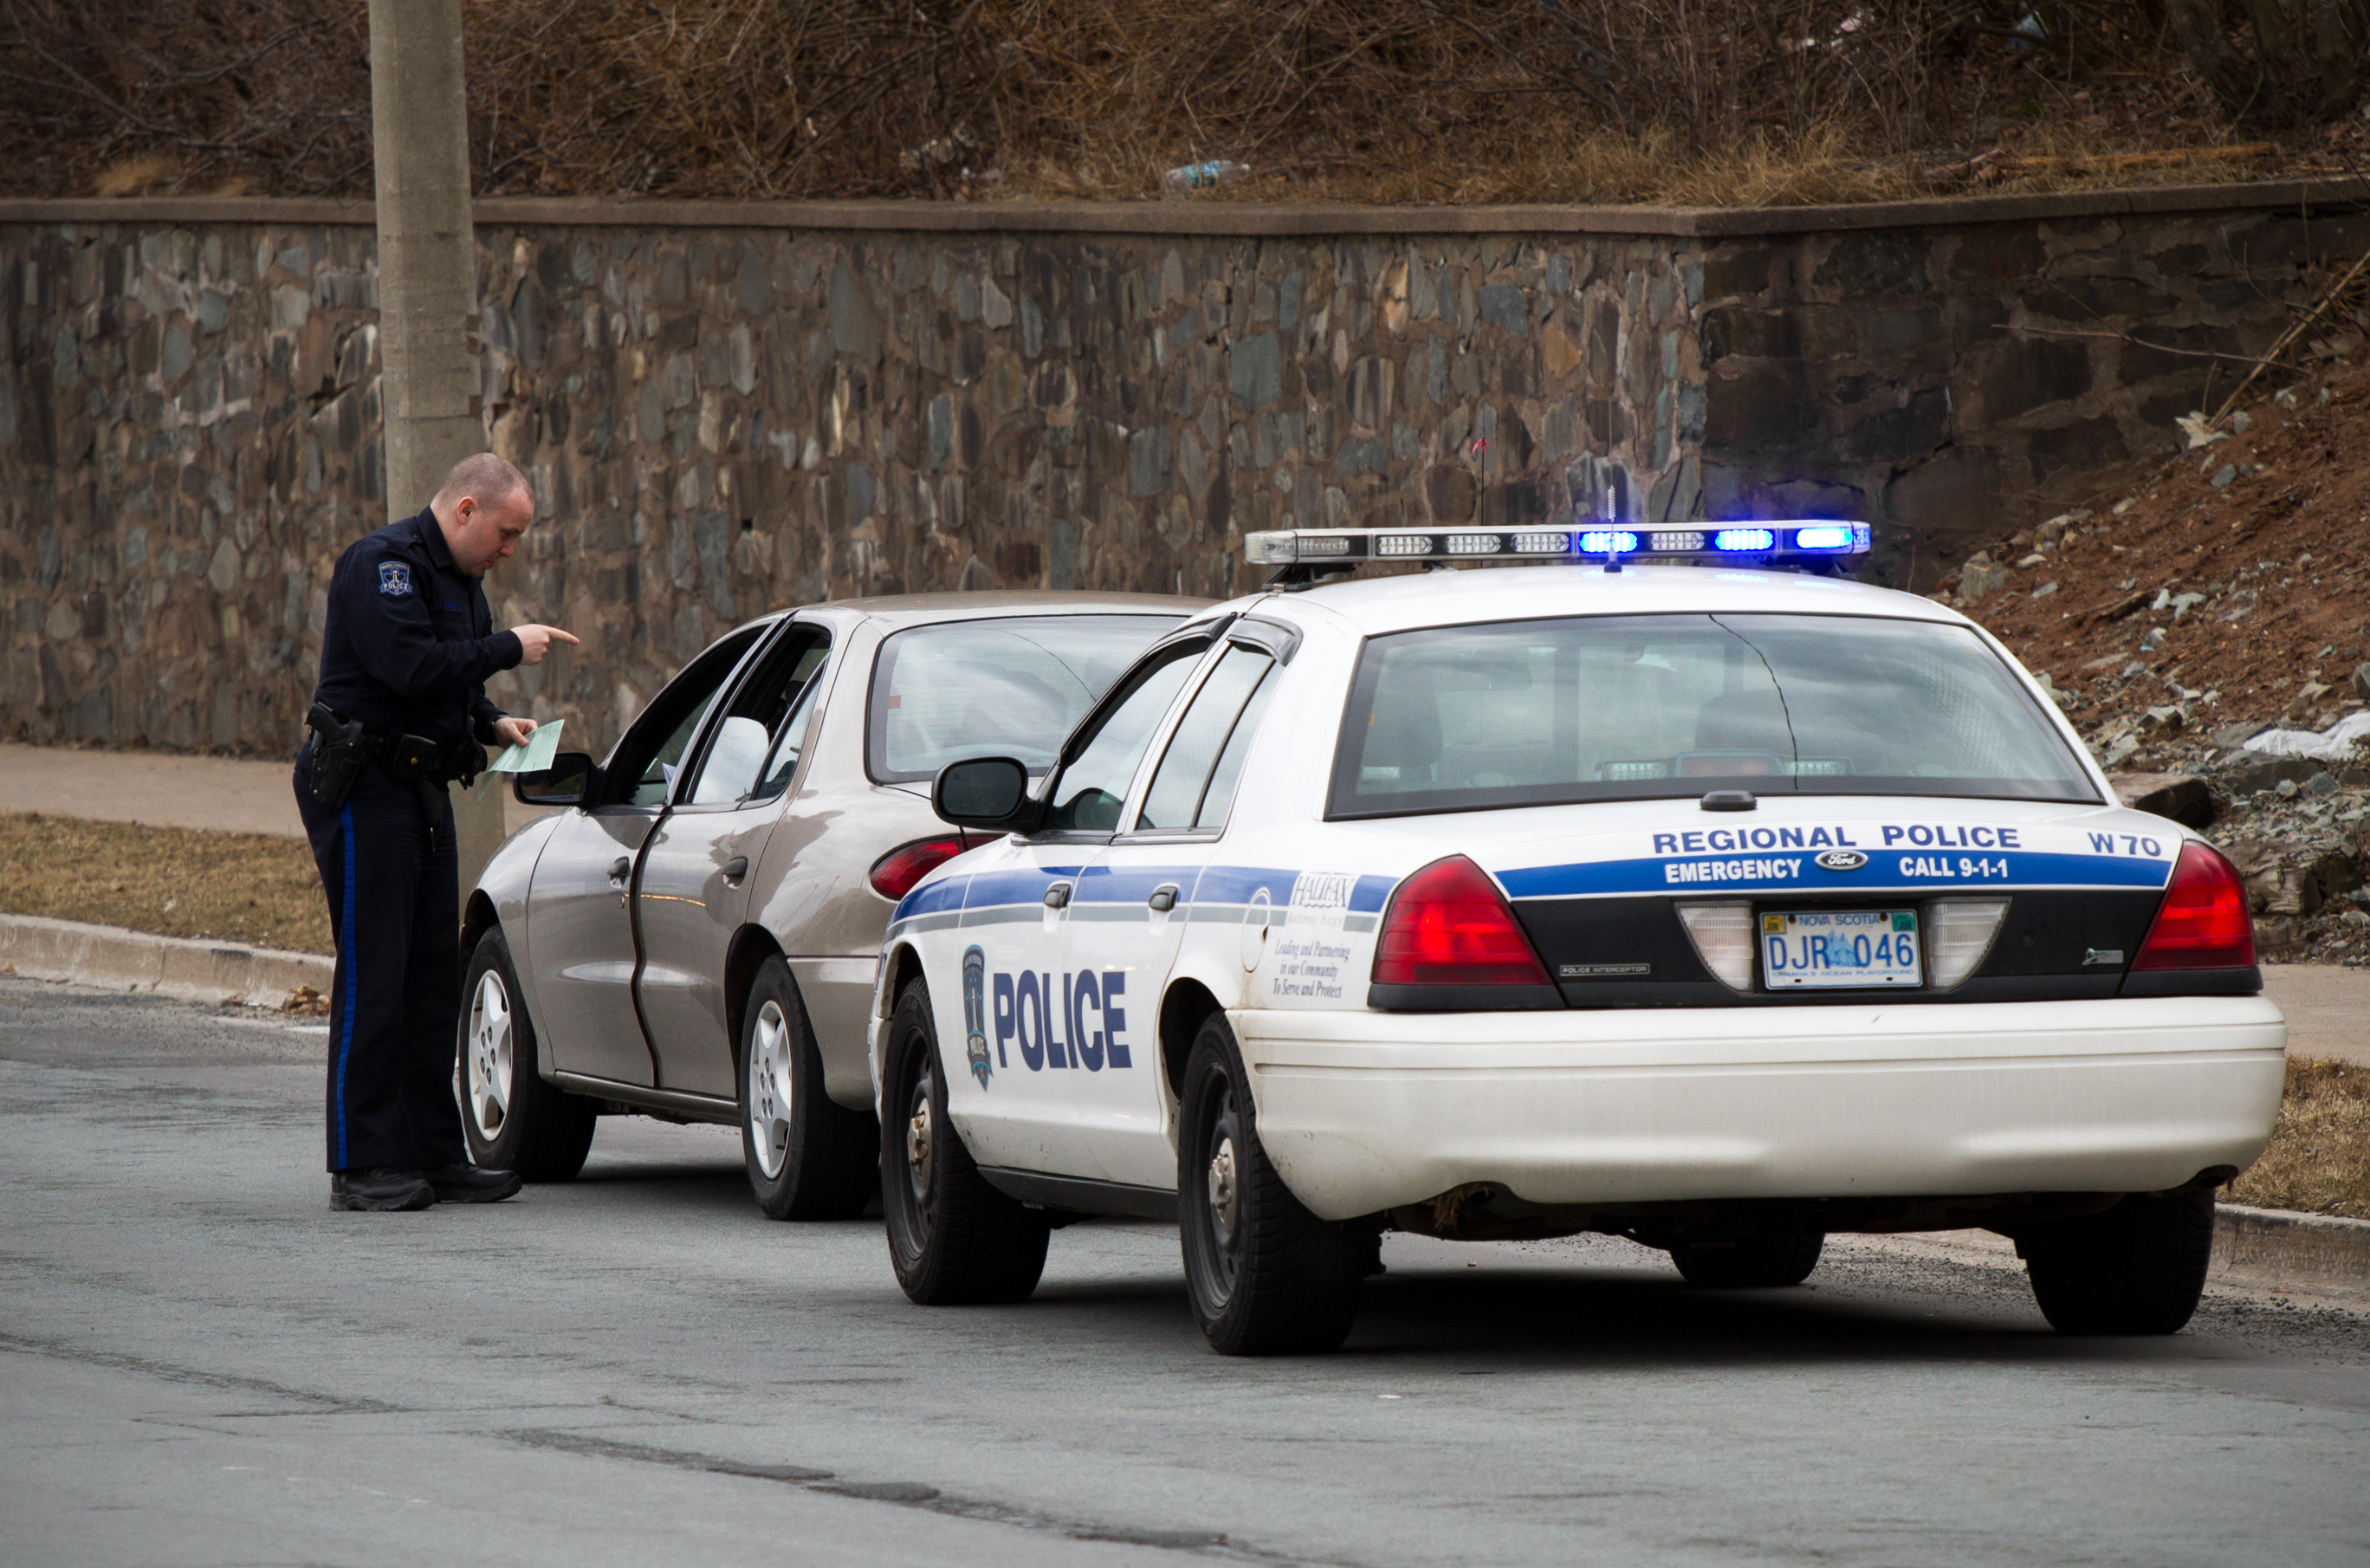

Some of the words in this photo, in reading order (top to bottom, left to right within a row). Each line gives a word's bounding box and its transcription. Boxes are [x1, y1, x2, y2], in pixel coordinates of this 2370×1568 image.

[1652, 826, 1856, 854] REGIONAL
[1881, 825, 2021, 849] POLICE
[2087, 832, 2114, 854] W
[2120, 834, 2161, 857] 70
[1827, 852, 1856, 865] Ford
[1899, 857, 1955, 877] CALL
[1959, 857, 2008, 878] 9-1-1
[1665, 859, 1802, 884] EMERGENCY
[1292, 875, 1355, 908] HALIFAX
[1798, 915, 1831, 926] NOVA
[1835, 914, 1881, 926] SCOTIA
[1274, 938, 1300, 961] Leading
[1300, 942, 1314, 957] and
[1313, 942, 1351, 963] Partnering
[1768, 935, 1830, 970] DJR
[1853, 933, 1914, 969] 046
[1279, 959, 1287, 975] in
[1287, 963, 1299, 975] our
[1300, 961, 1339, 982] Community
[1273, 978, 1281, 995] To
[1281, 979, 1300, 996] Serve
[1301, 981, 1316, 997] and
[1316, 981, 1343, 999] Protect
[993, 969, 1133, 1072] POLICE
